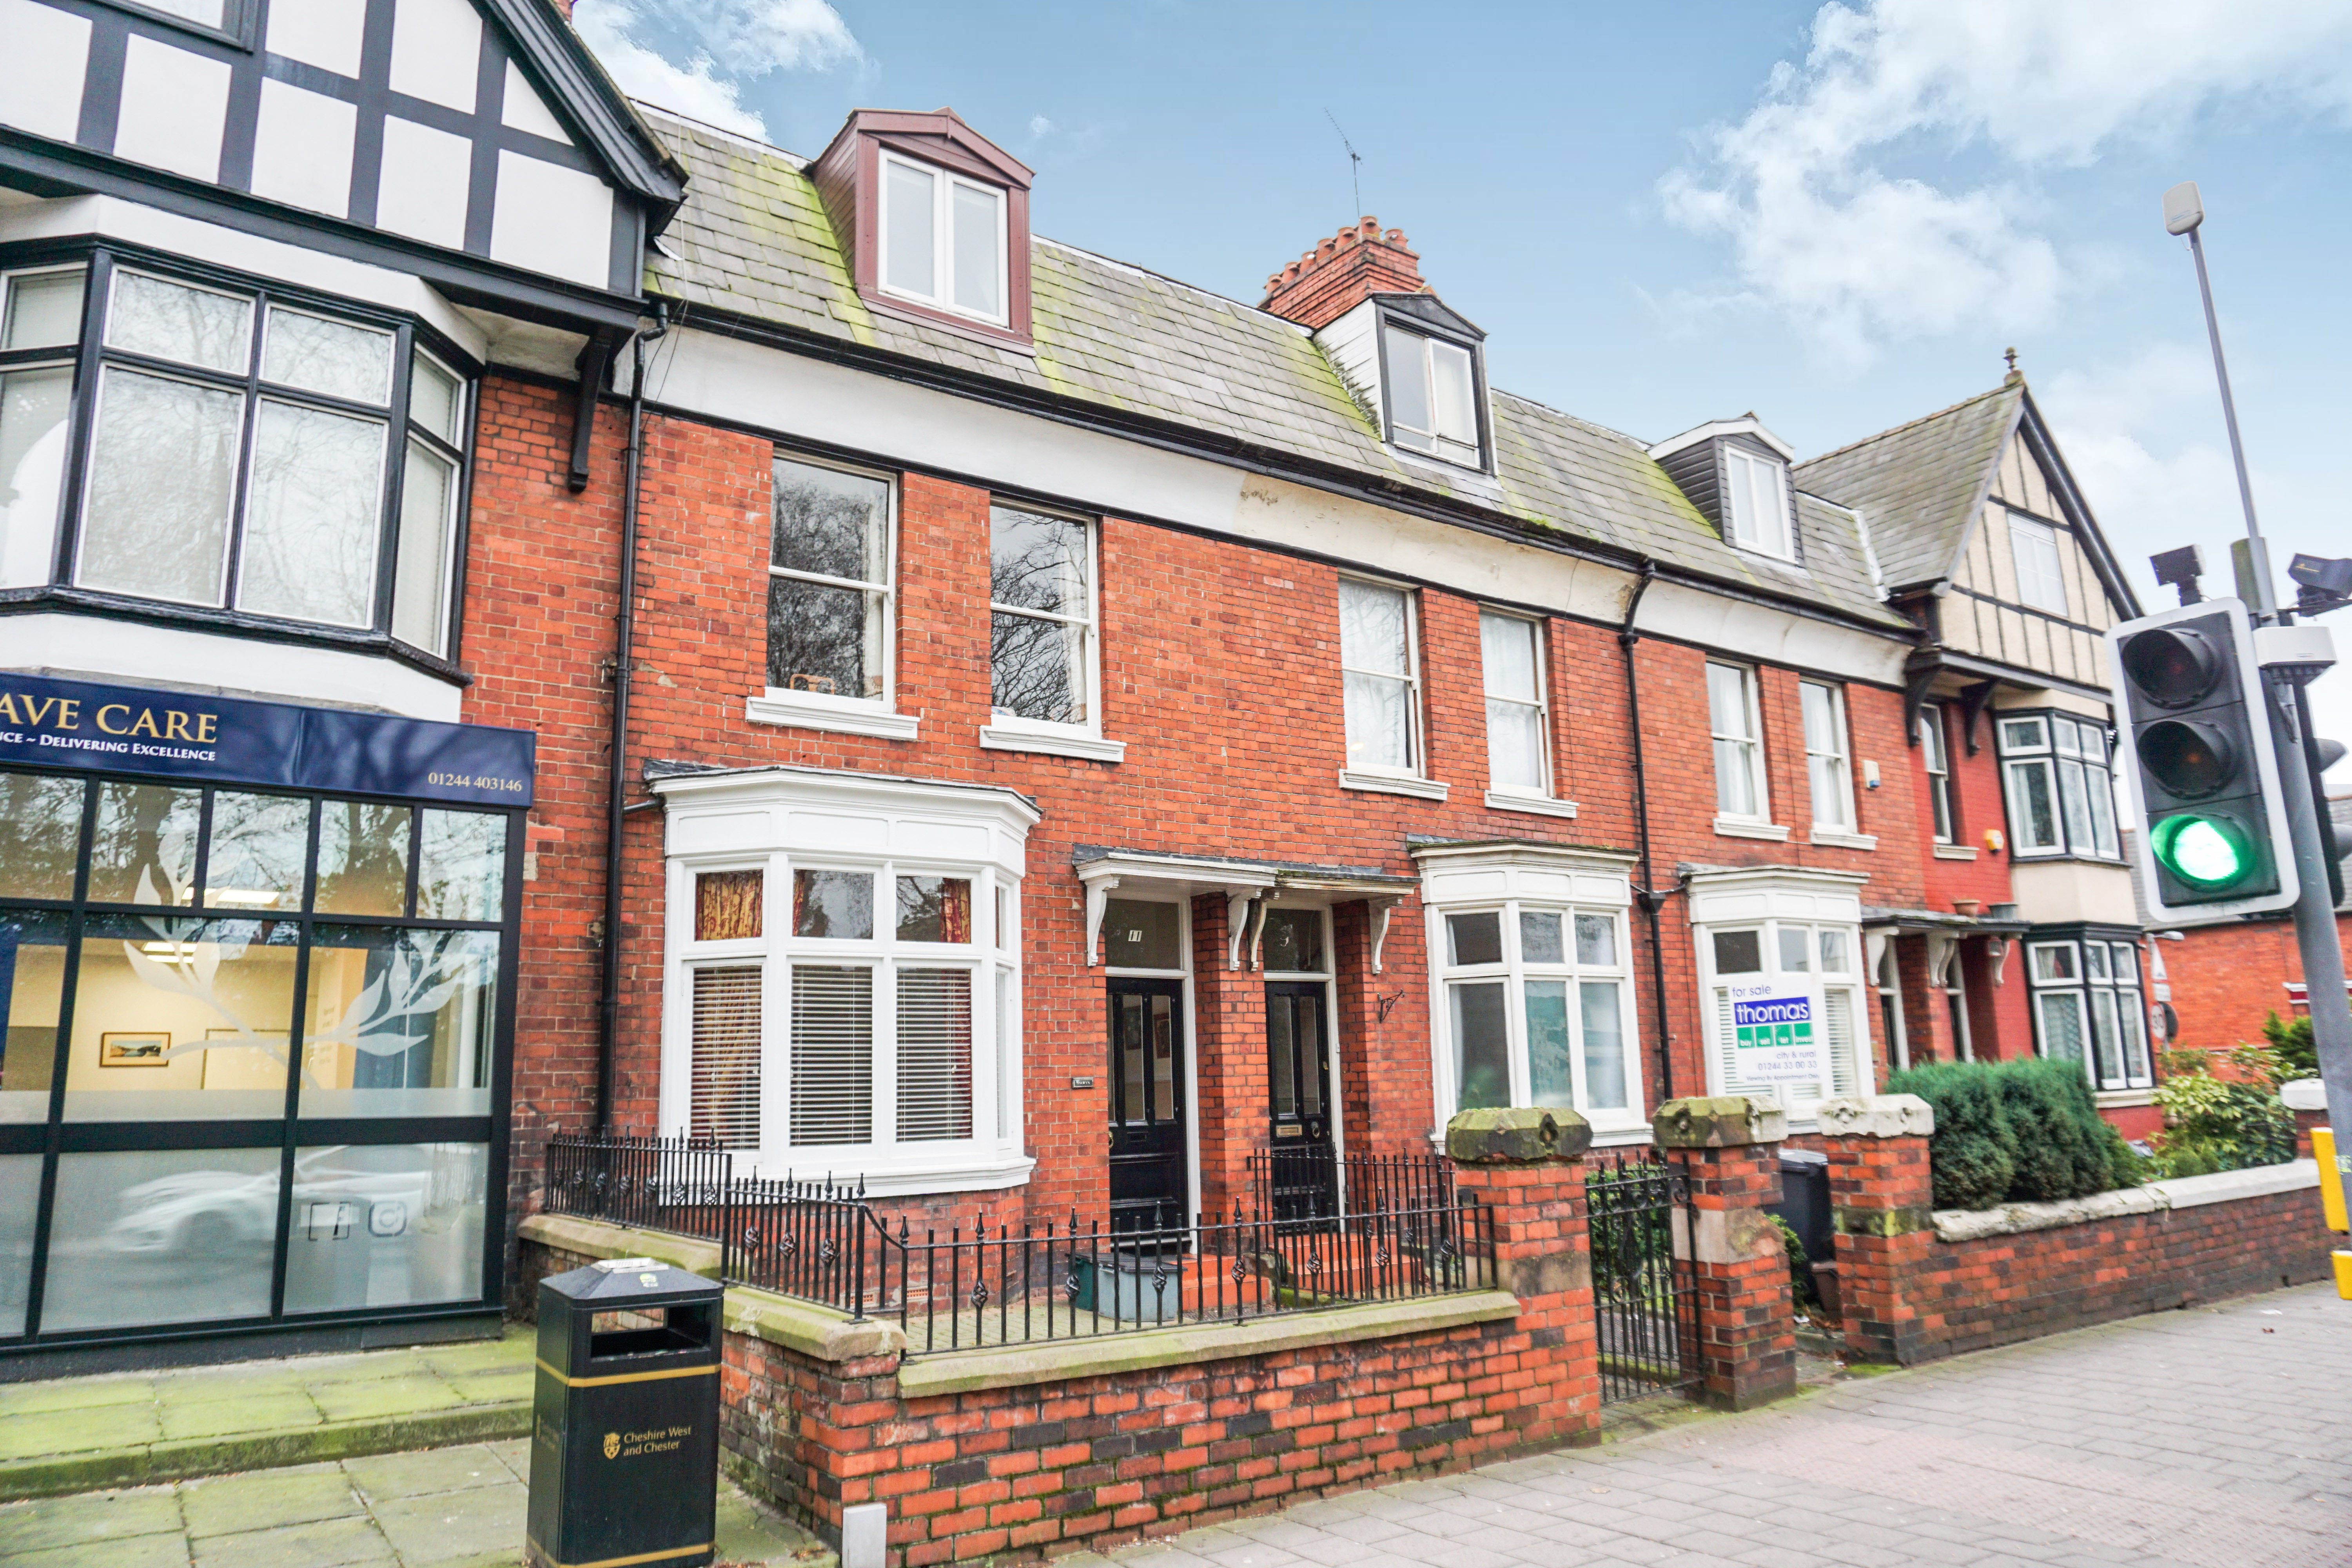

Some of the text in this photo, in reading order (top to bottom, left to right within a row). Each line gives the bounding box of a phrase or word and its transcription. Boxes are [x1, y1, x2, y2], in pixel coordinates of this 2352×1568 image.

[0, 693, 218, 743] AVE CARE
[428, 772, 522, 792] 01244 403146
[1732, 984, 1772, 997] for sale
[1737, 1003, 1808, 1023] thomas
[2153, 1014, 2164, 1029] 30
[1776, 1052, 1789, 1060] city
[624, 1426, 691, 1444] Cheshire West
[623, 1441, 680, 1457] and Chester
